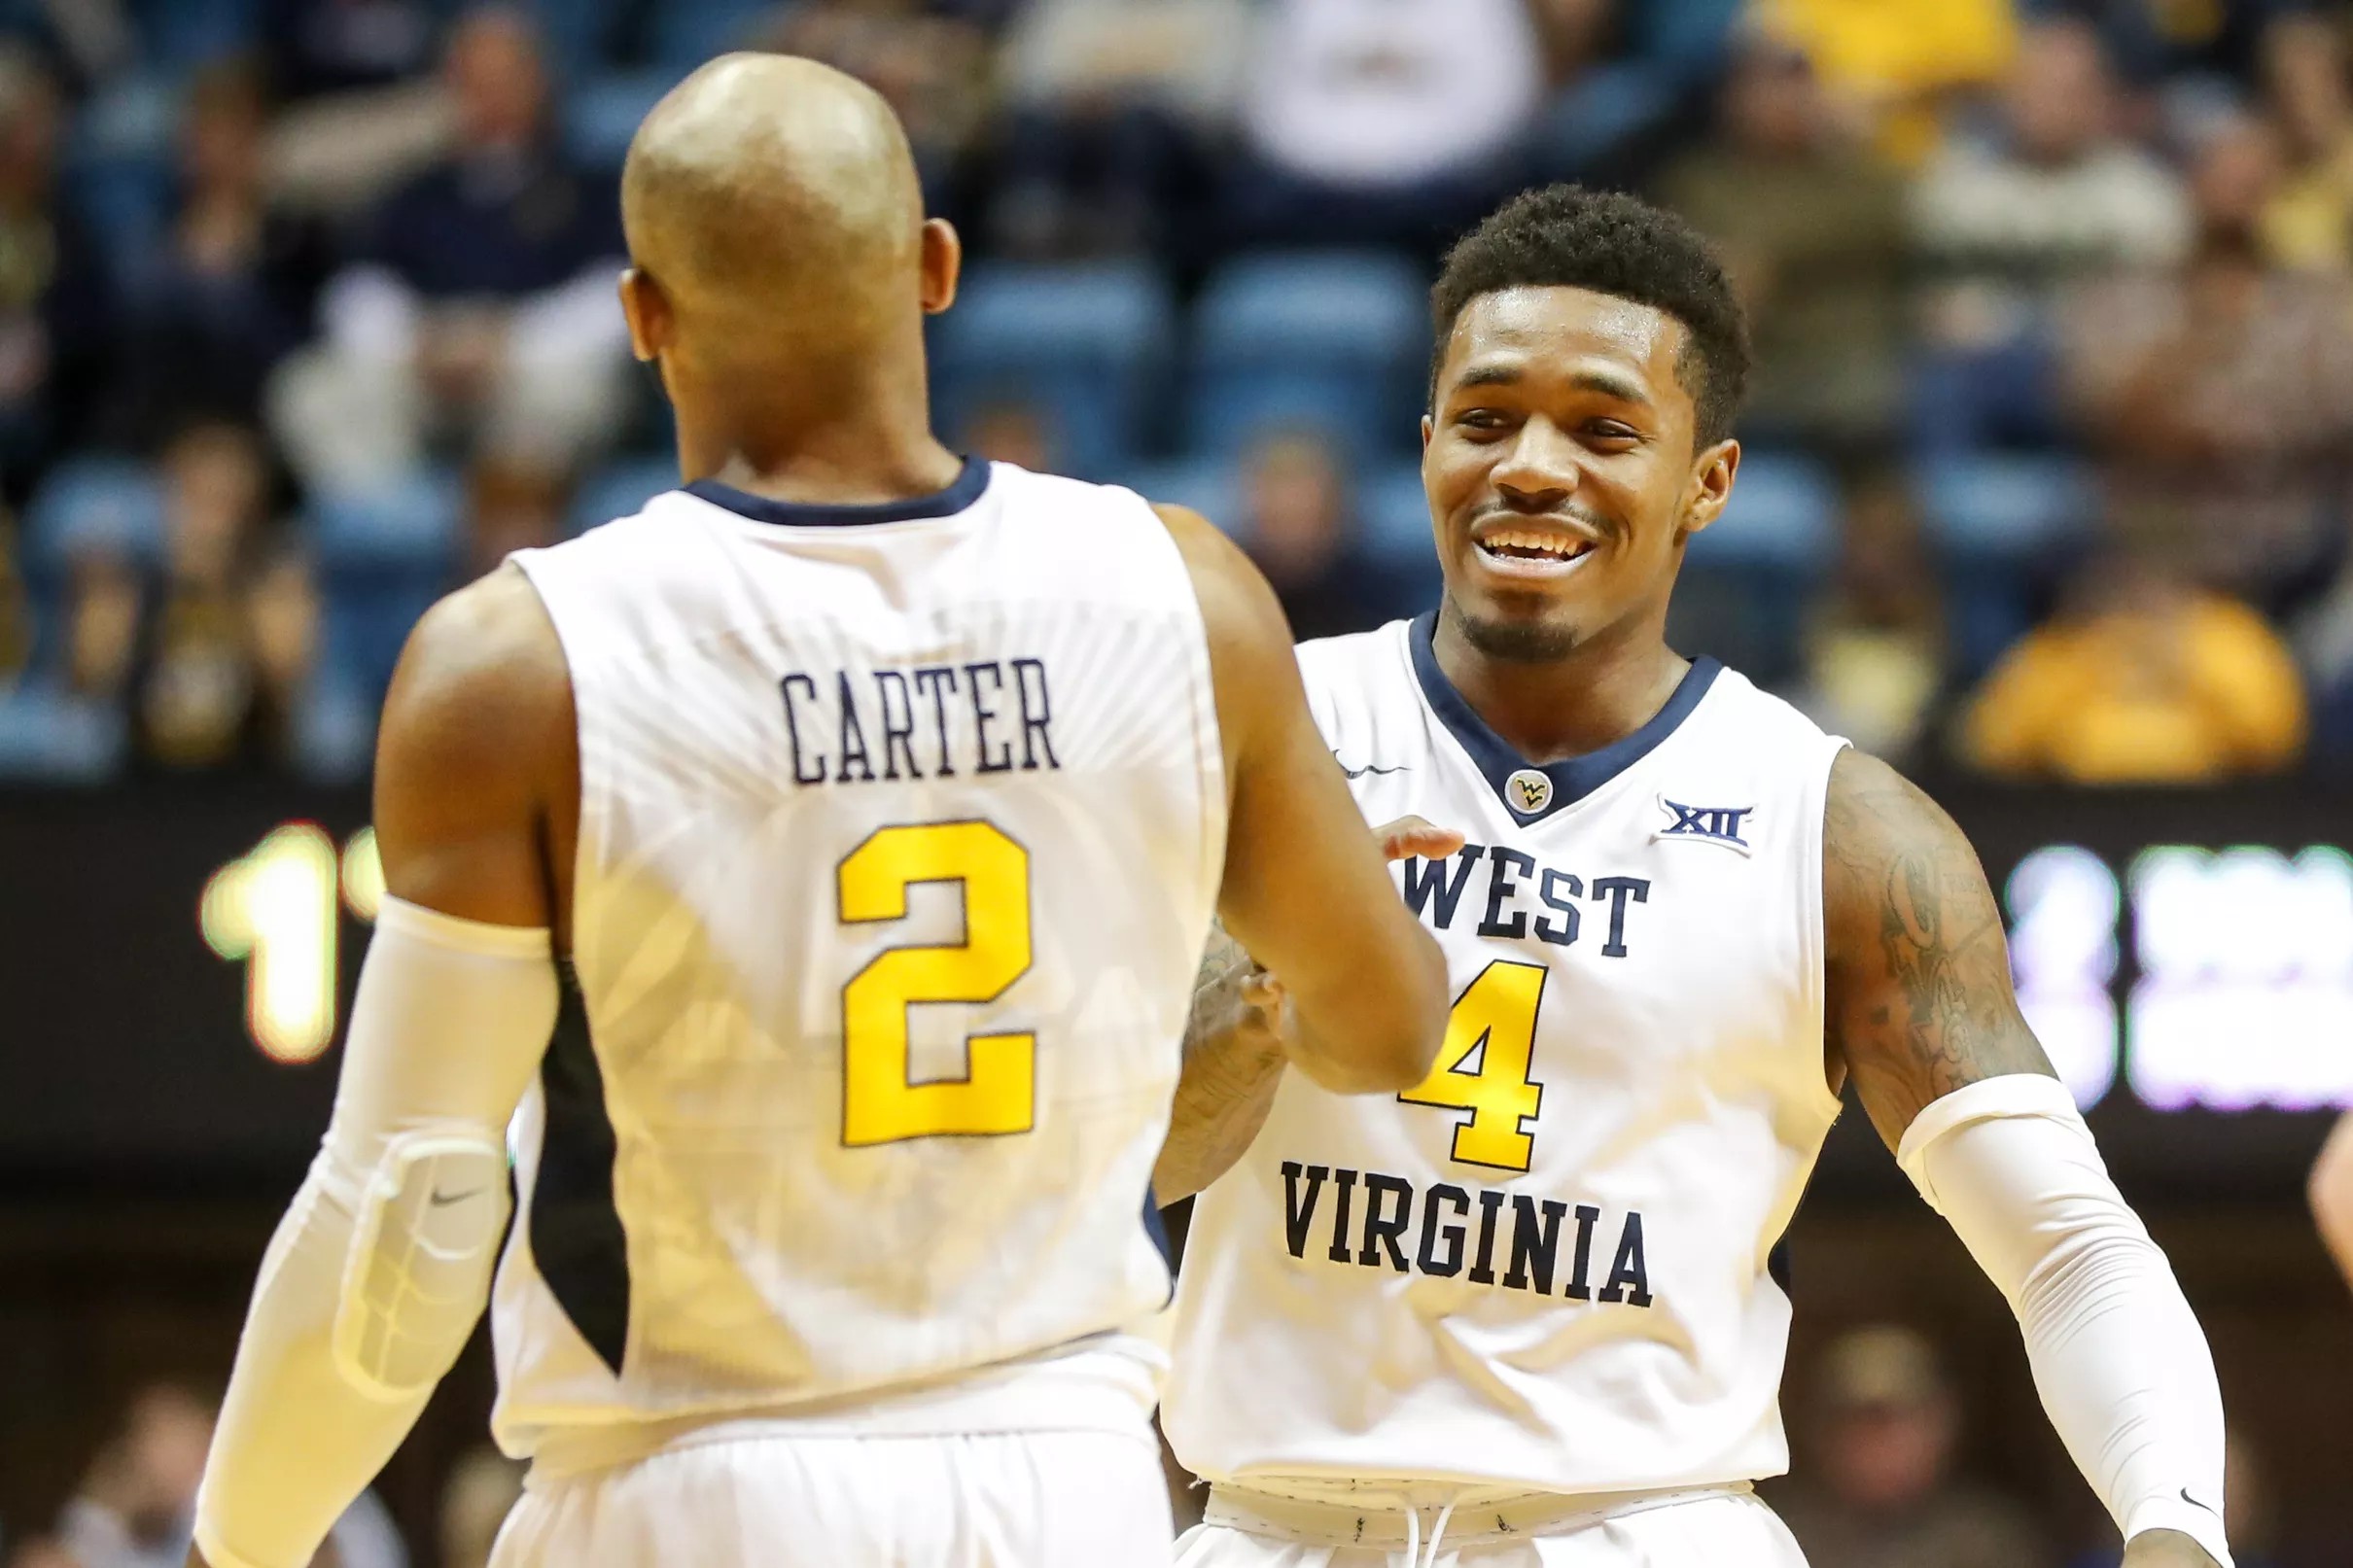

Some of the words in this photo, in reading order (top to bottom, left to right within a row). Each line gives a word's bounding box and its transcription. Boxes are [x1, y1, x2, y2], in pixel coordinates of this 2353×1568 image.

[780, 658, 1060, 784] CARTER
[1659, 797, 1755, 849] XII
[1404, 843, 1652, 958] WEST
[835, 817, 1036, 1148] 2
[1396, 958, 1550, 1172] 4
[1281, 1162, 1653, 1308] VIRGINIA
